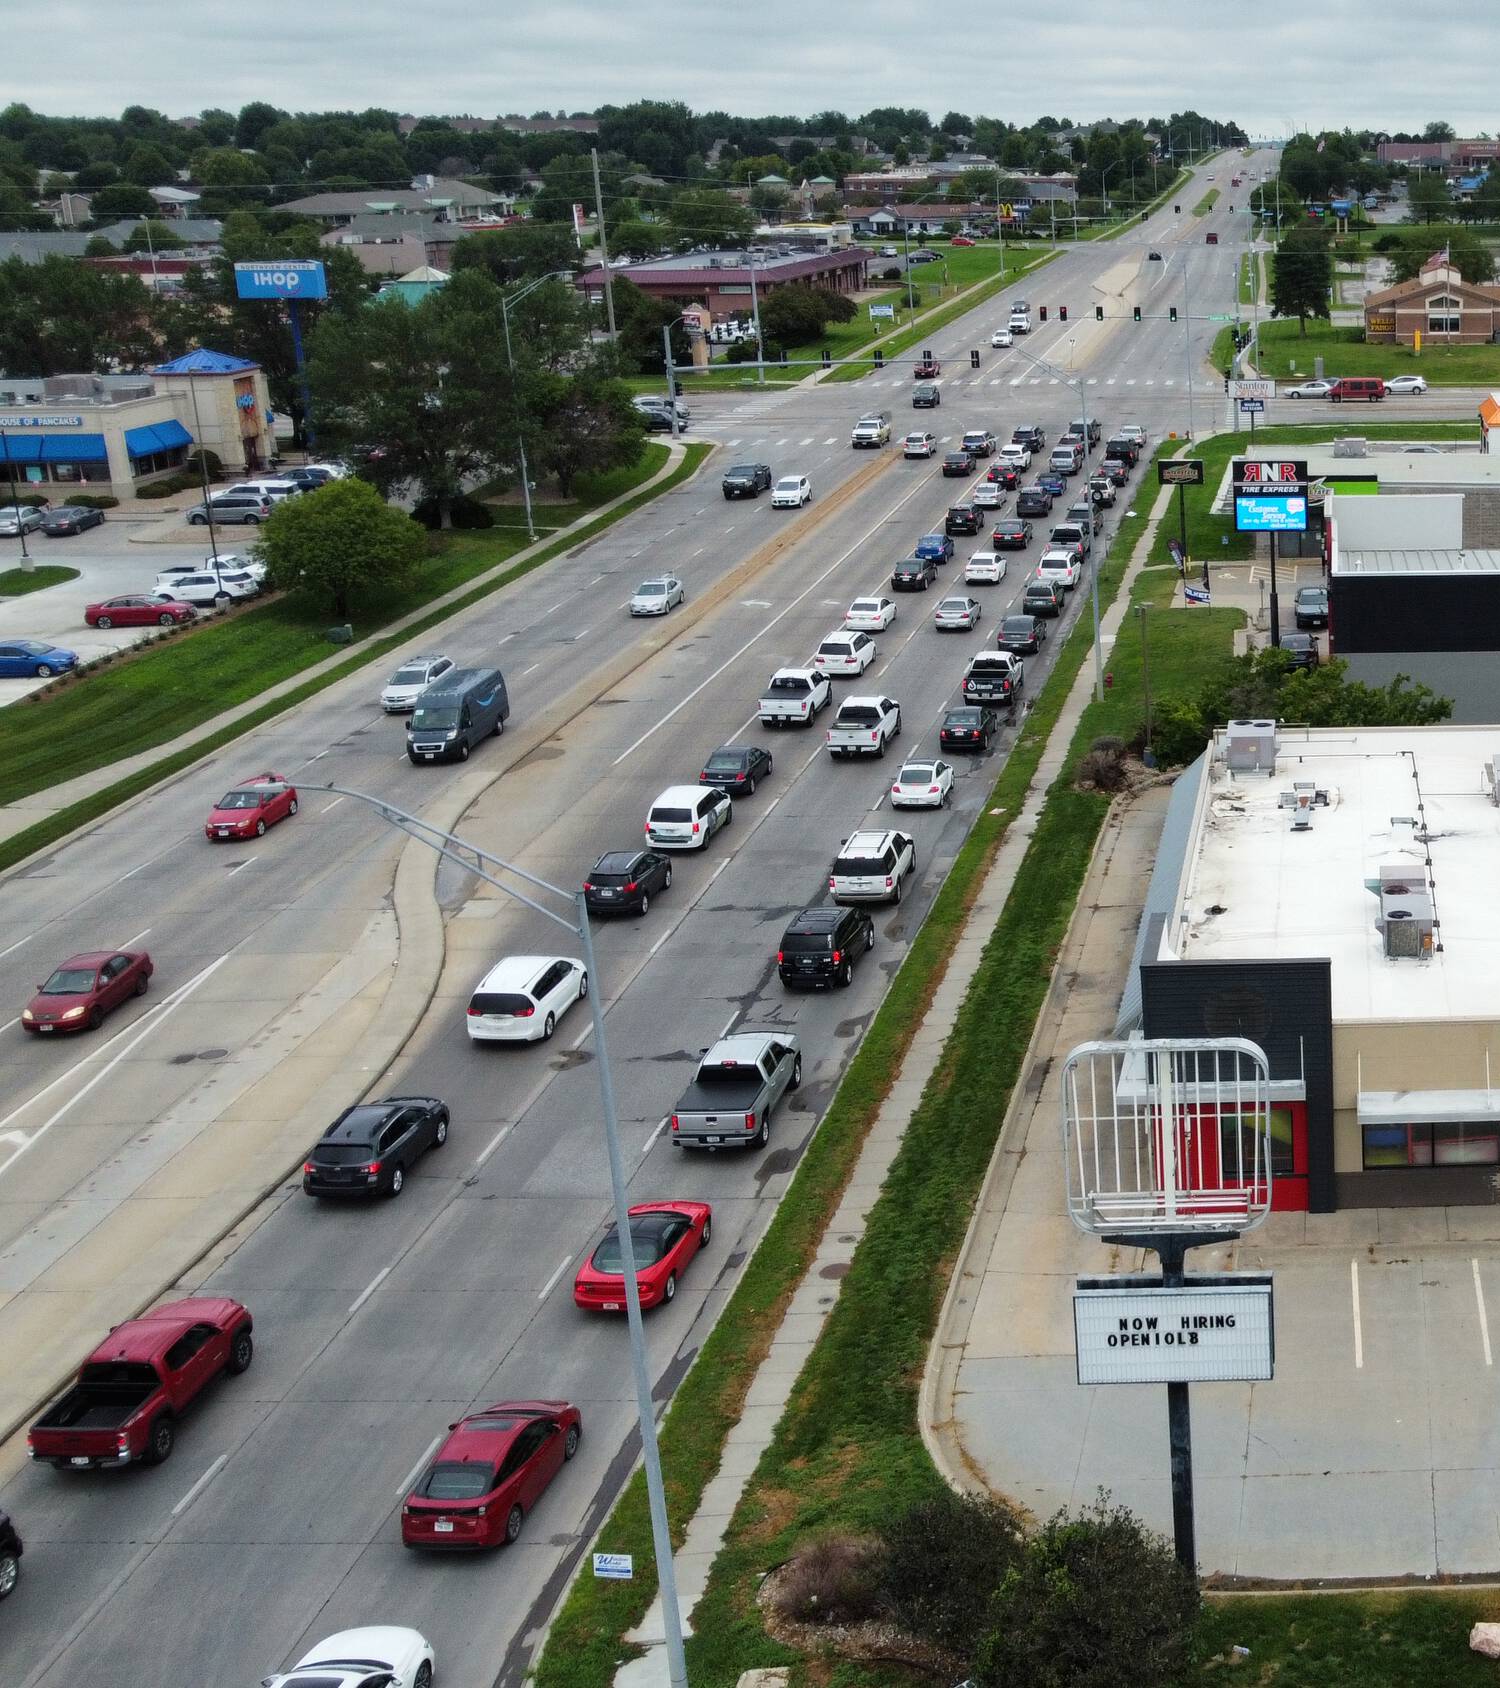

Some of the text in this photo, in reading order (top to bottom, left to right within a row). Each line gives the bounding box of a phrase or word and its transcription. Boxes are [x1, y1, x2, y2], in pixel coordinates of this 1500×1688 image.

[1235, 381, 1269, 390] Stanton
[38, 416, 78, 426] PANCAKES
[1243, 463, 1298, 481] RNR
[1119, 1315, 1236, 1331] NOW HIRING
